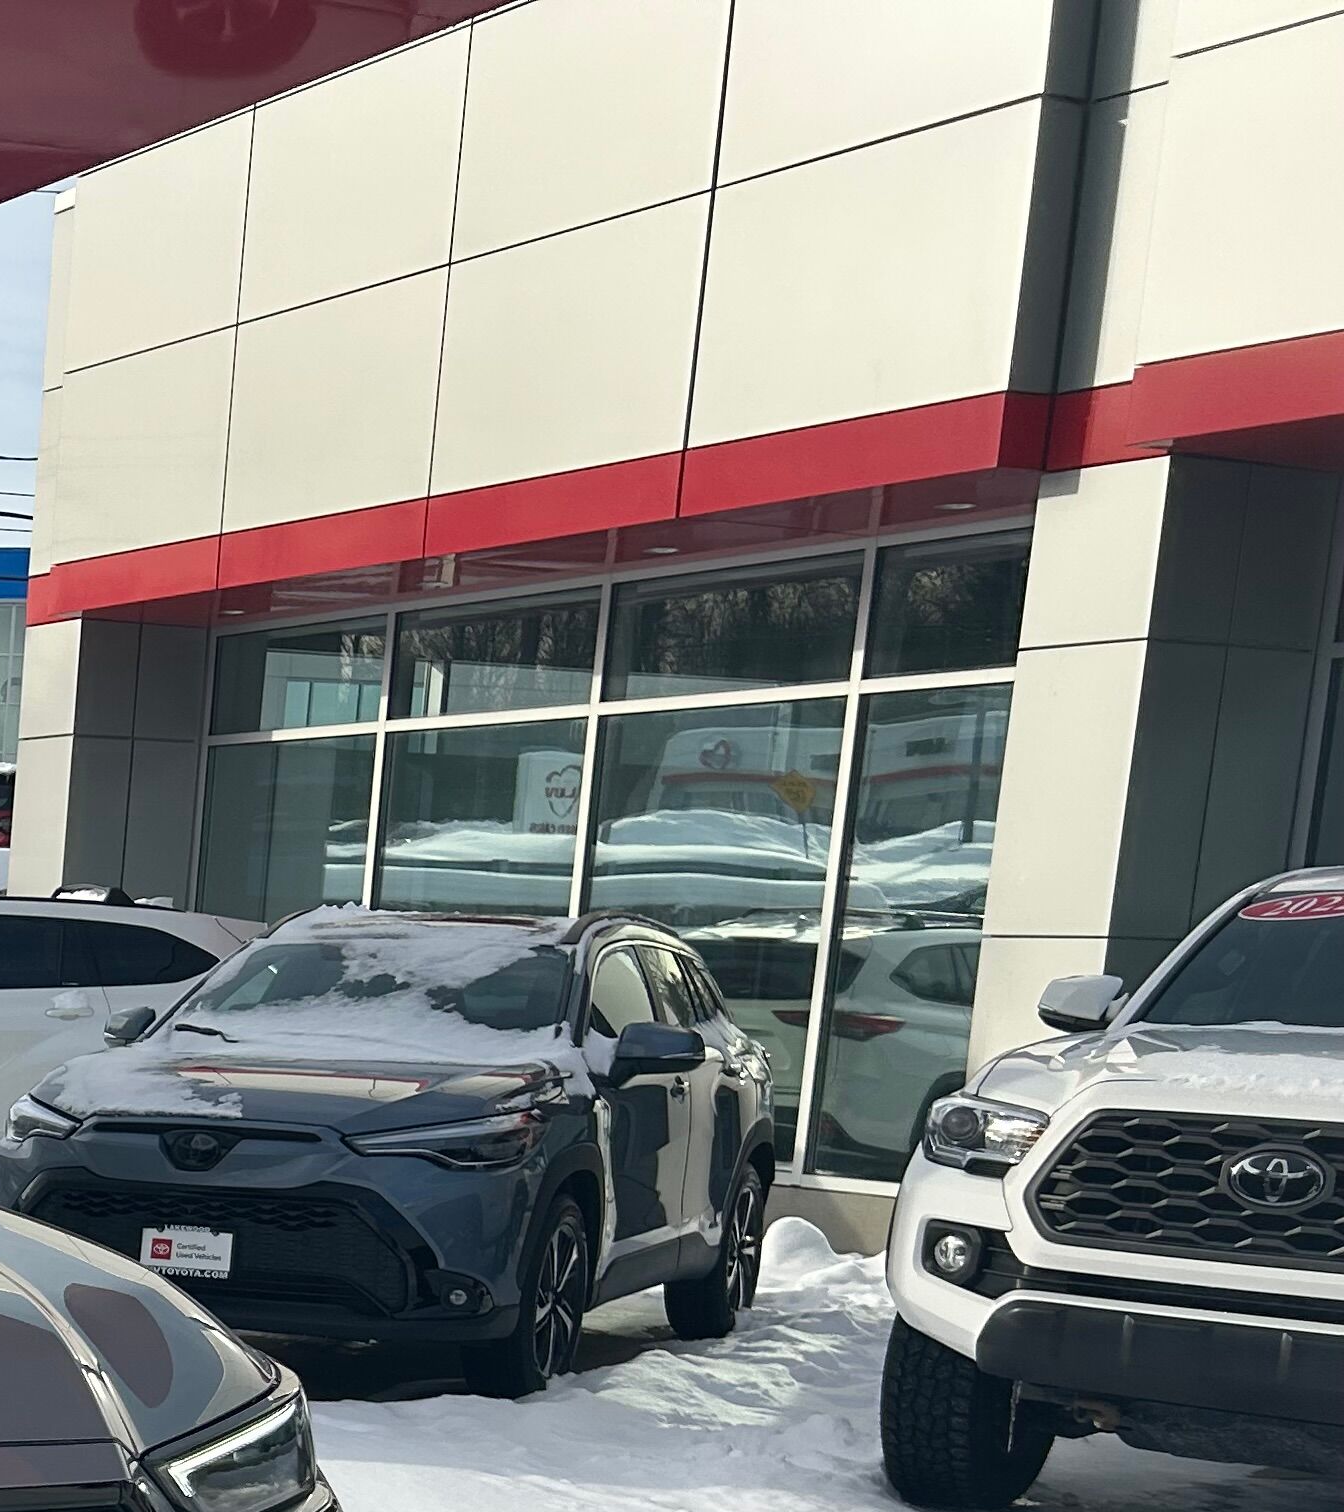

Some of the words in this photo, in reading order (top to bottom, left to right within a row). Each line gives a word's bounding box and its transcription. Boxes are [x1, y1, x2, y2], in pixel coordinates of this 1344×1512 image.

[1260, 896, 1344, 917] 202
[164, 1224, 211, 1233] LAKEWOOD
[176, 1242, 206, 1251] Certified
[153, 1266, 229, 1279] VTOYOTA.COM
